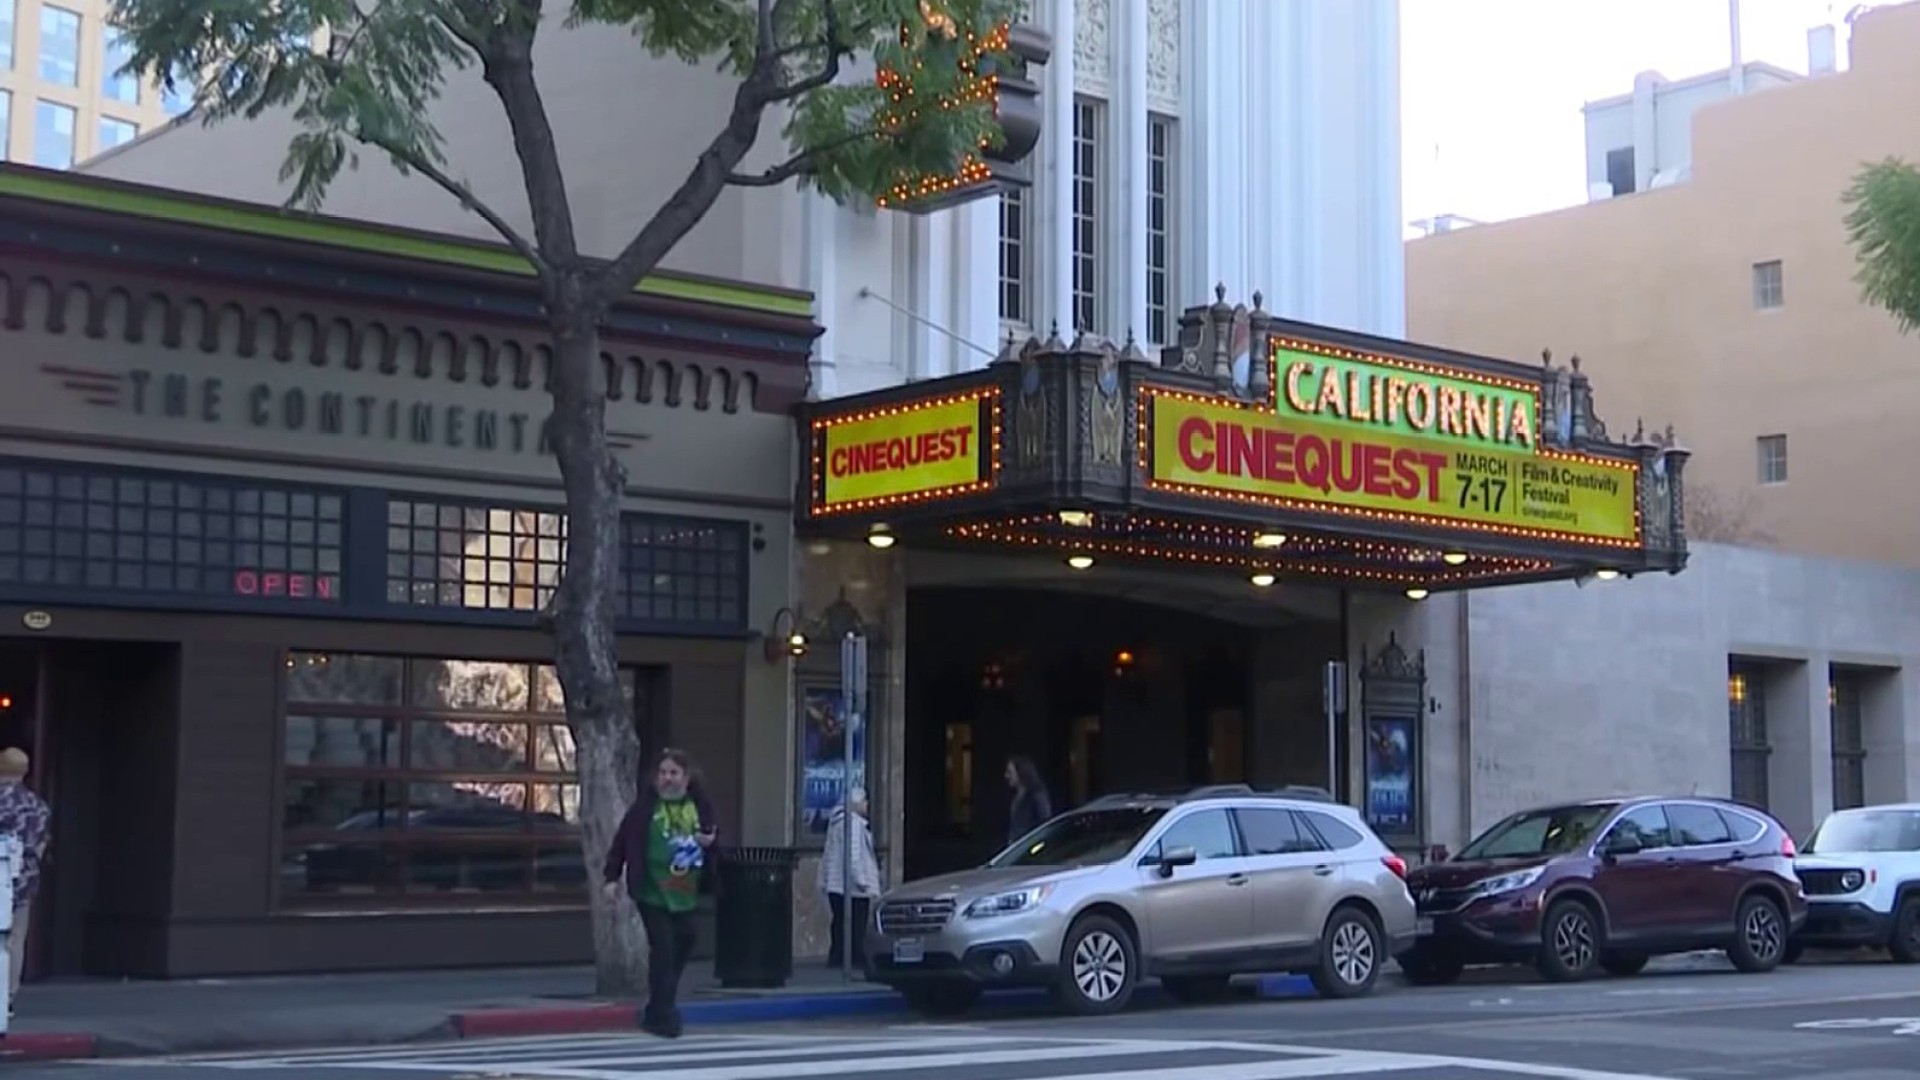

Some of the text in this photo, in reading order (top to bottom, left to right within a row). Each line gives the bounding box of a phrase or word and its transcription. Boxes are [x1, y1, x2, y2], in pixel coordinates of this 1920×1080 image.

[129, 369, 557, 456] THE CONTINENTA
[1286, 361, 1534, 448] CALIFORNIA
[830, 425, 973, 479] CINEQUEST
[1177, 415, 1448, 503] CINEQUEST
[1456, 452, 1508, 476] MARCH
[1456, 473, 1508, 513] 7-17
[1522, 461, 1619, 497] Film & Creativity
[1522, 482, 1571, 505] Festival
[235, 568, 331, 600] OPEN
